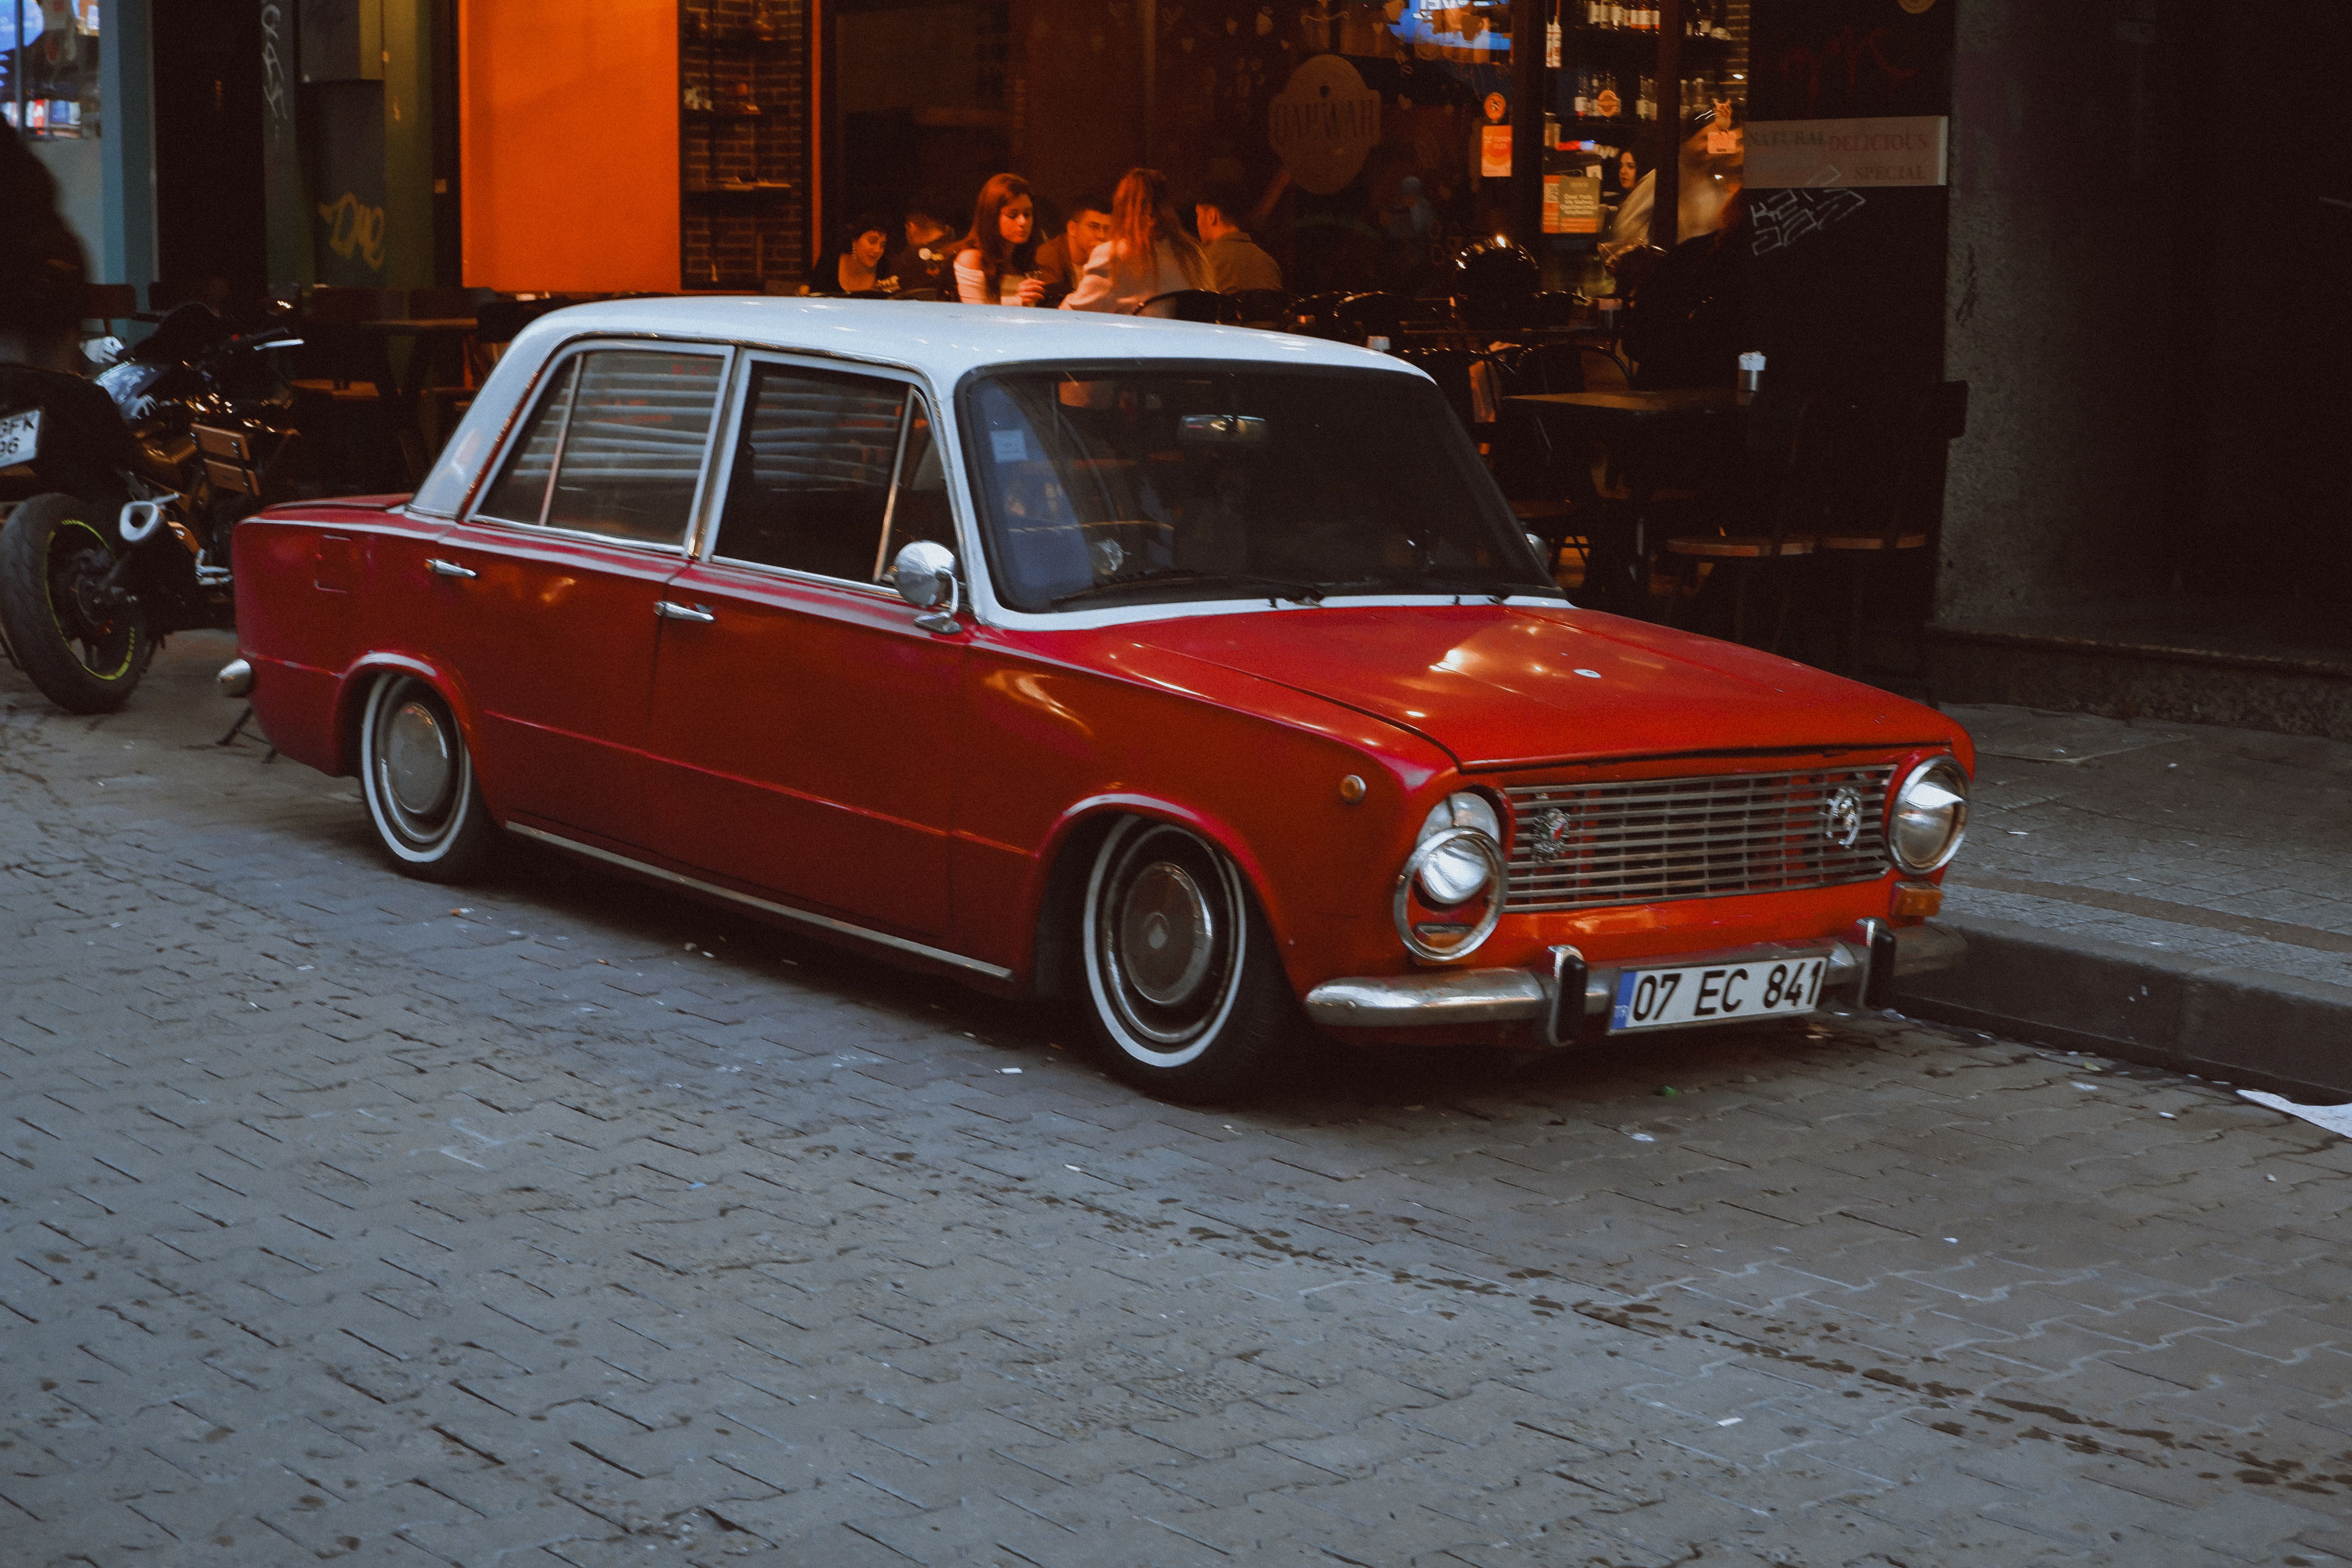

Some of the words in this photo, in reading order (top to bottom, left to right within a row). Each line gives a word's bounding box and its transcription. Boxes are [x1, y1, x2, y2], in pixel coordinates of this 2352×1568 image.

[1748, 130, 1825, 146] NATURAL
[1828, 133, 1930, 151] DELICIOUS
[1854, 165, 1926, 180] SPECIAL
[1633, 973, 1682, 1022] 07
[1693, 968, 1749, 1016] EC
[1762, 960, 1824, 1009] 841
